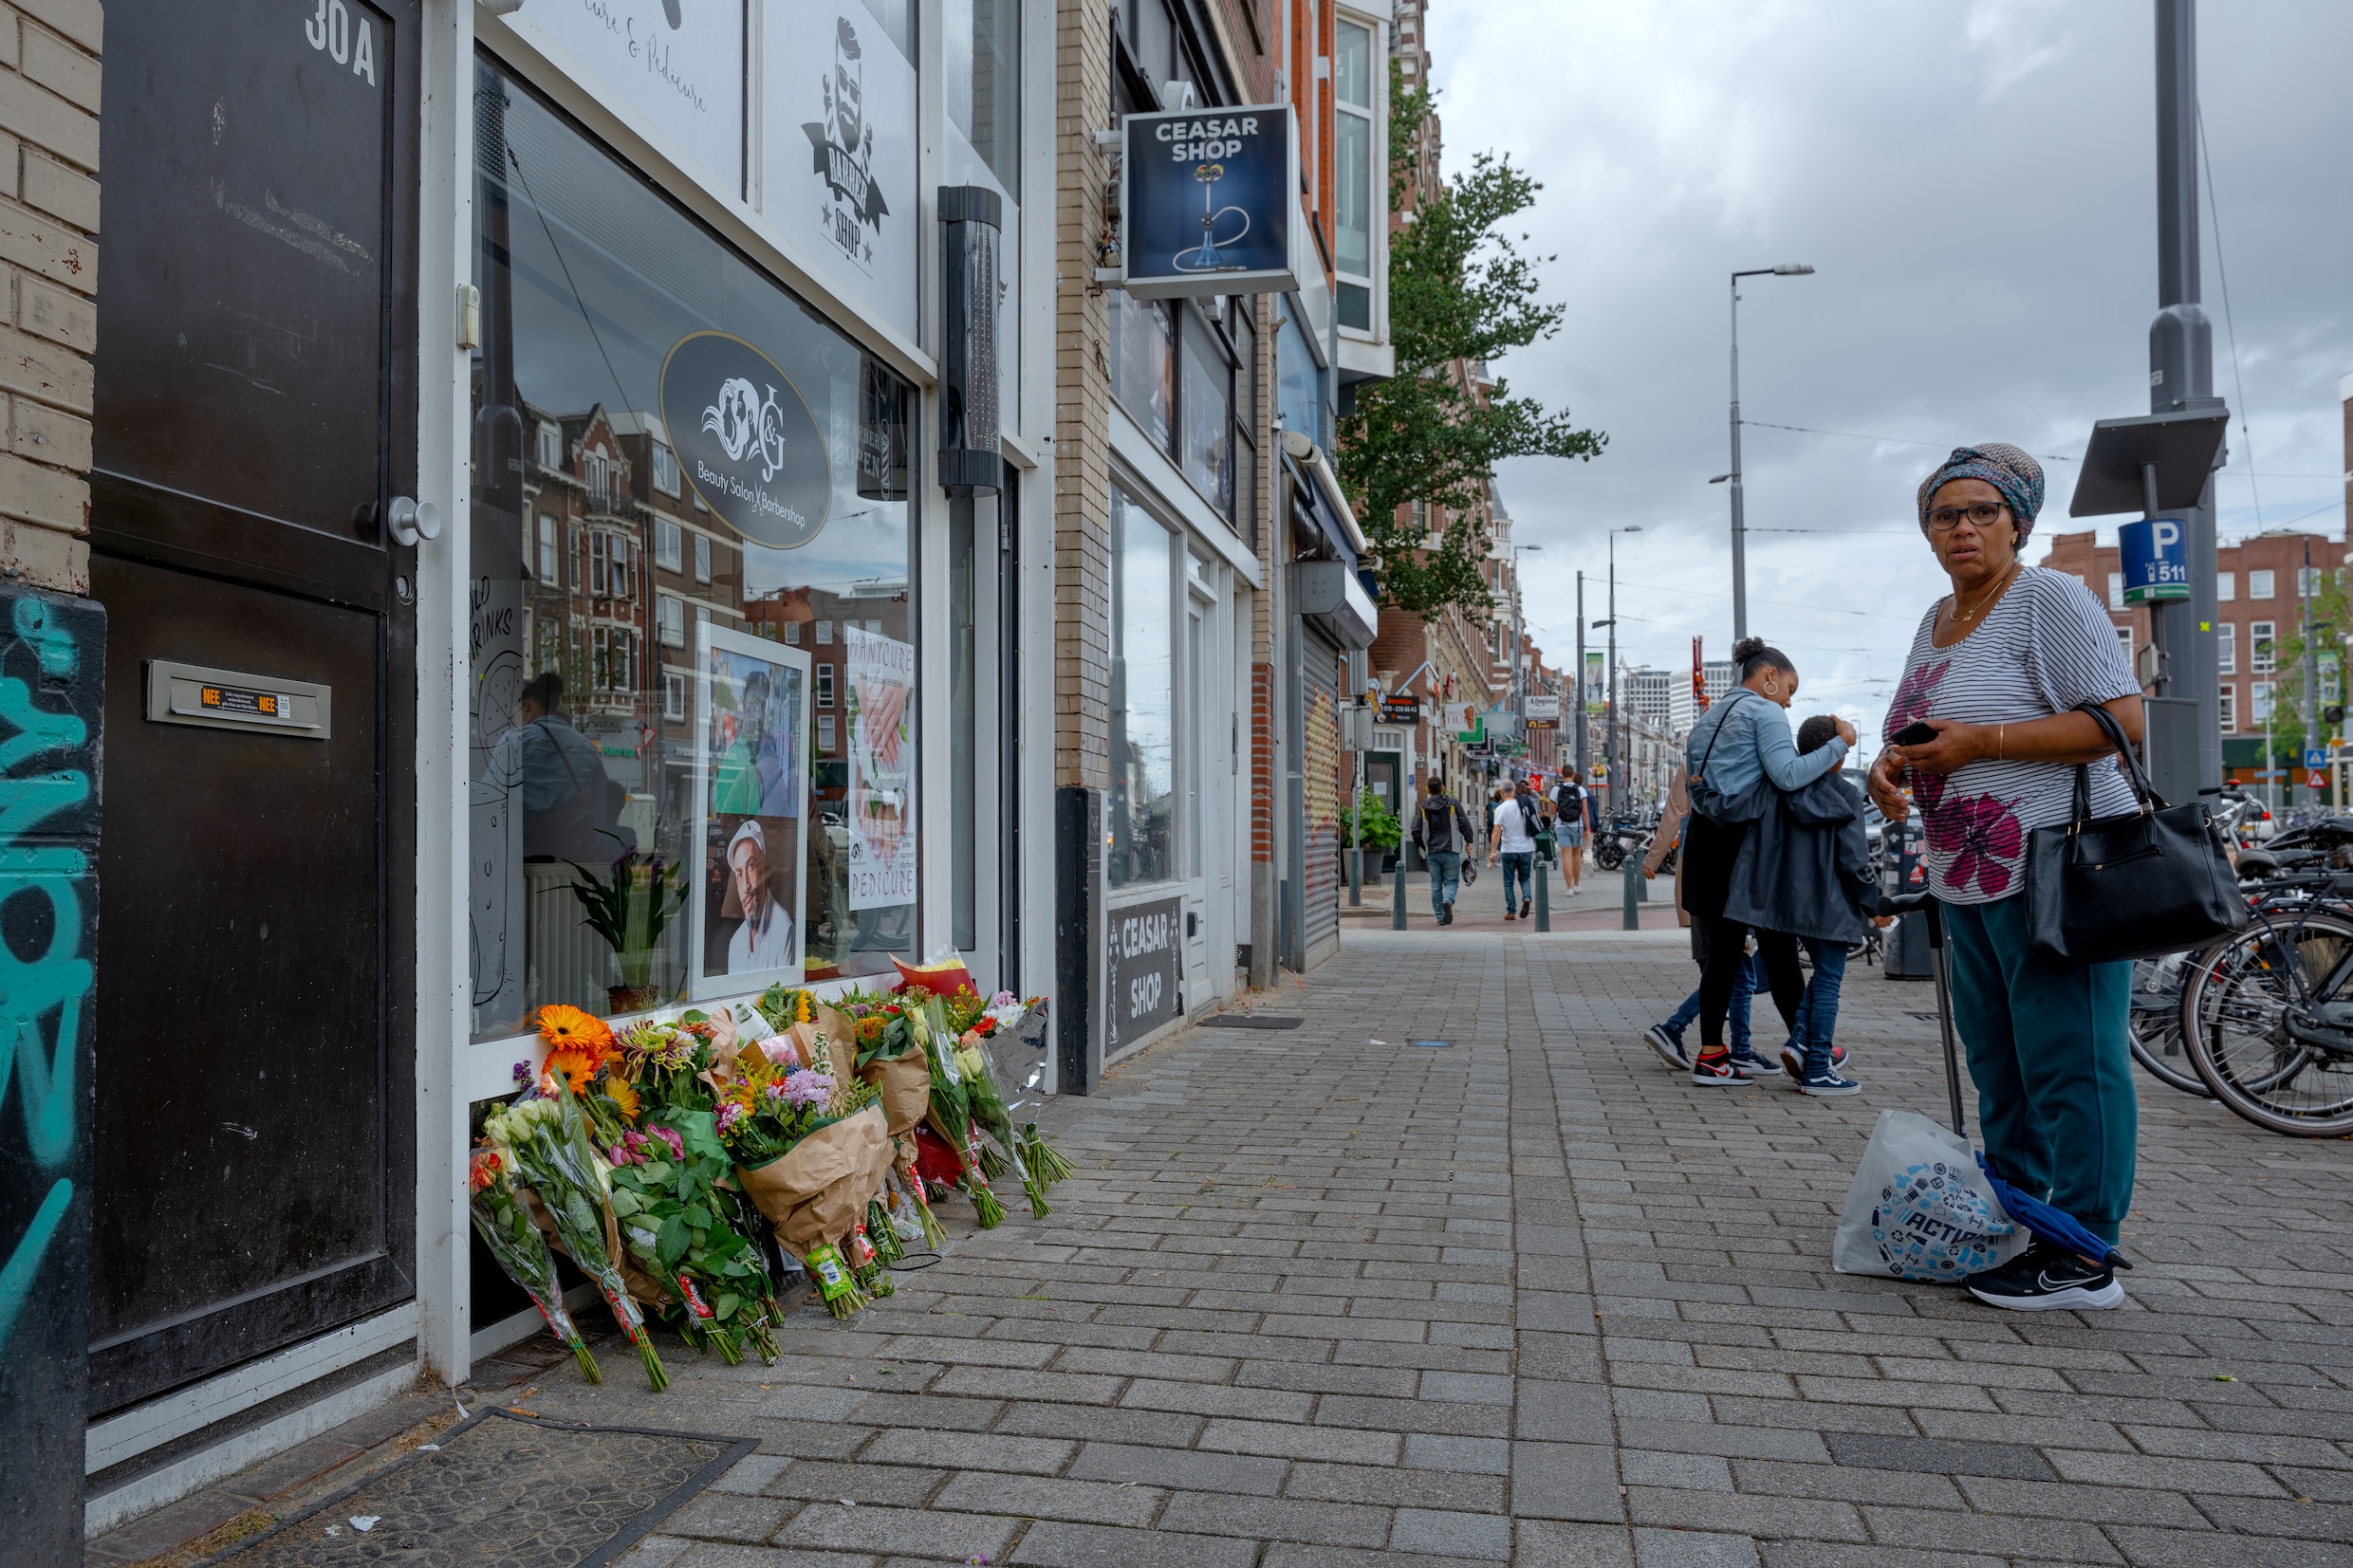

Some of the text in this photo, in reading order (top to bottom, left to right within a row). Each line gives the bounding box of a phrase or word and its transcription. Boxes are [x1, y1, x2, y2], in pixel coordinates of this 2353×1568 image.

[306, 0, 375, 87] 30A
[646, 34, 708, 112] Pedicure
[1156, 117, 1259, 141] CEASAR
[1172, 140, 1242, 162] SHOP
[827, 146, 868, 214] BARBER
[835, 207, 861, 258] SHOP
[844, 417, 880, 451] BARBER
[846, 443, 880, 479] OPEN
[698, 460, 806, 530] Beauty Salon Barbershop
[2152, 522, 2179, 560] P
[2158, 565, 2185, 581] 511
[202, 688, 220, 705] NEE
[258, 696, 275, 712] NEE
[1528, 697, 1557, 707] Almina
[852, 870, 913, 898] PEDICURE
[1122, 913, 1168, 959] CEASAR
[1131, 971, 1161, 1019] SHOP
[1905, 1265, 1953, 1280] action.com
